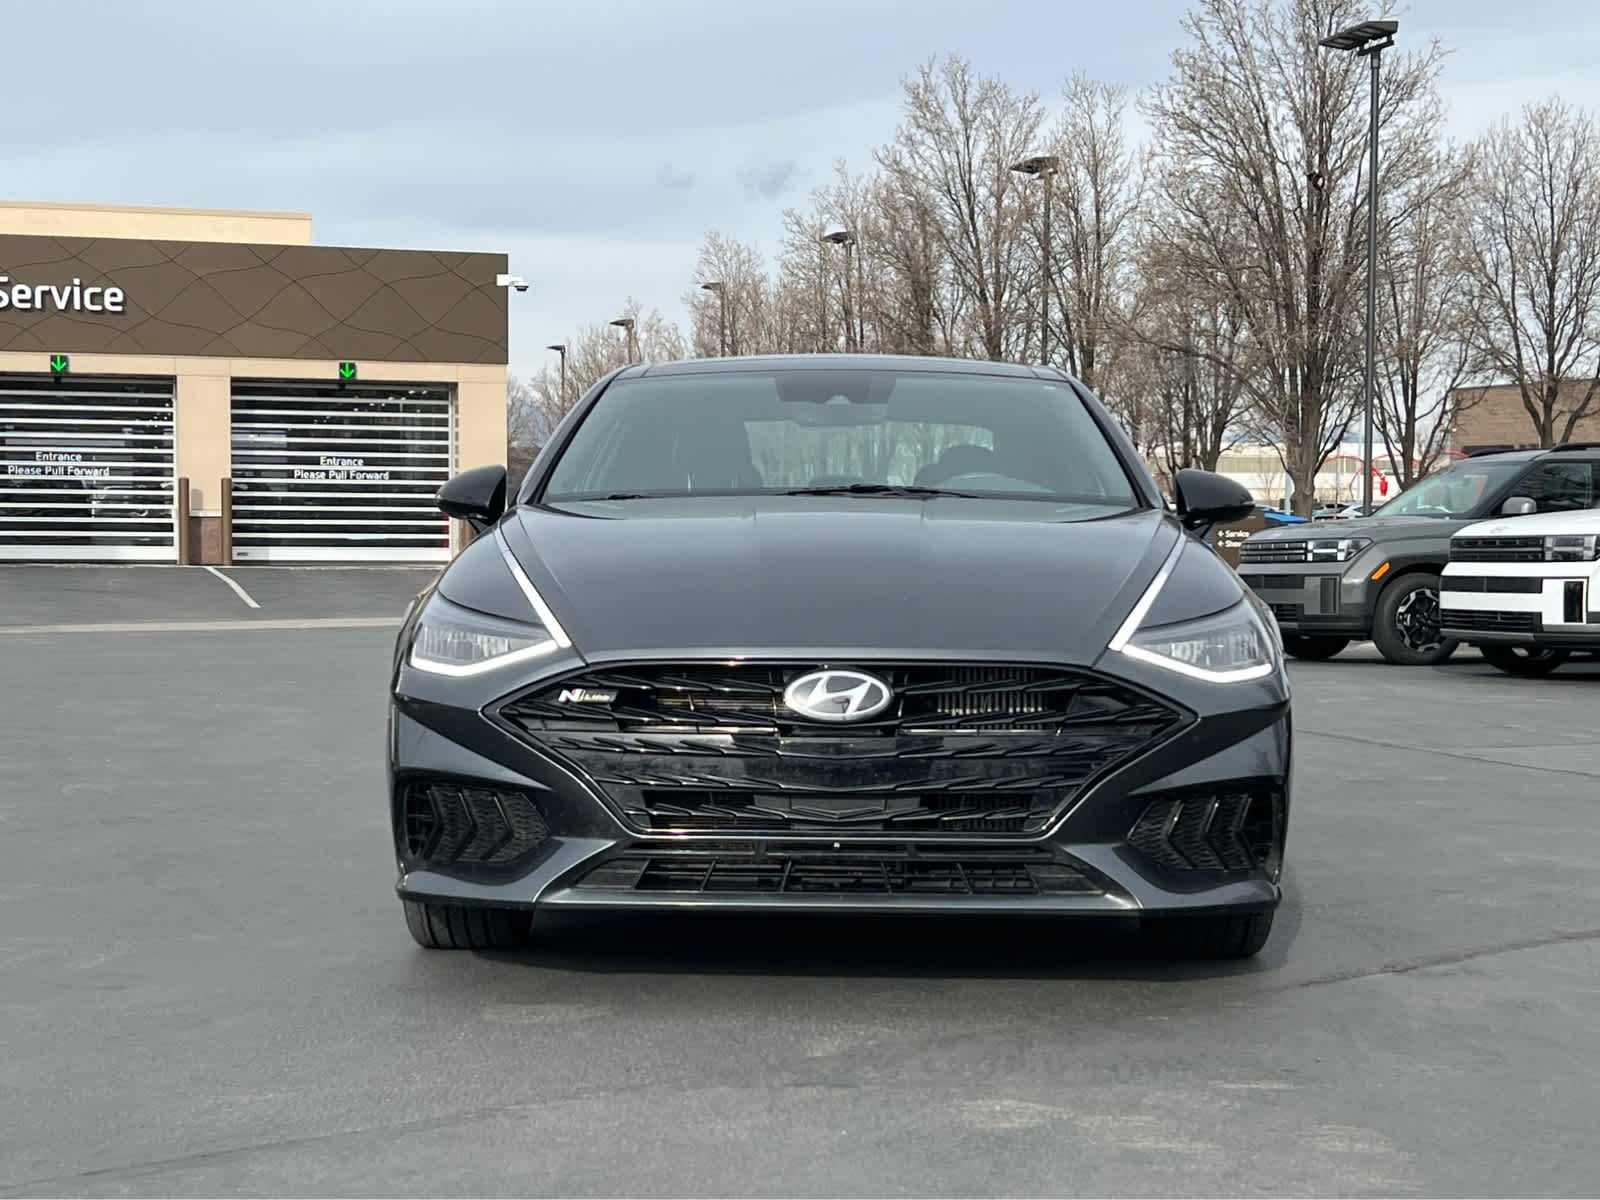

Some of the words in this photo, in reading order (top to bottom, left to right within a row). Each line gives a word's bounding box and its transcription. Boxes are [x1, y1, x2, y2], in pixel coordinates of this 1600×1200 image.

[0, 276, 124, 311] Service
[35, 452, 82, 461] Entrance
[320, 456, 364, 466] Entrance
[8, 466, 41, 475] Please
[45, 466, 64, 475] Pull
[67, 466, 110, 476] Forward
[294, 469, 326, 479] Please
[328, 470, 347, 479] Pull
[349, 470, 390, 480] Forward
